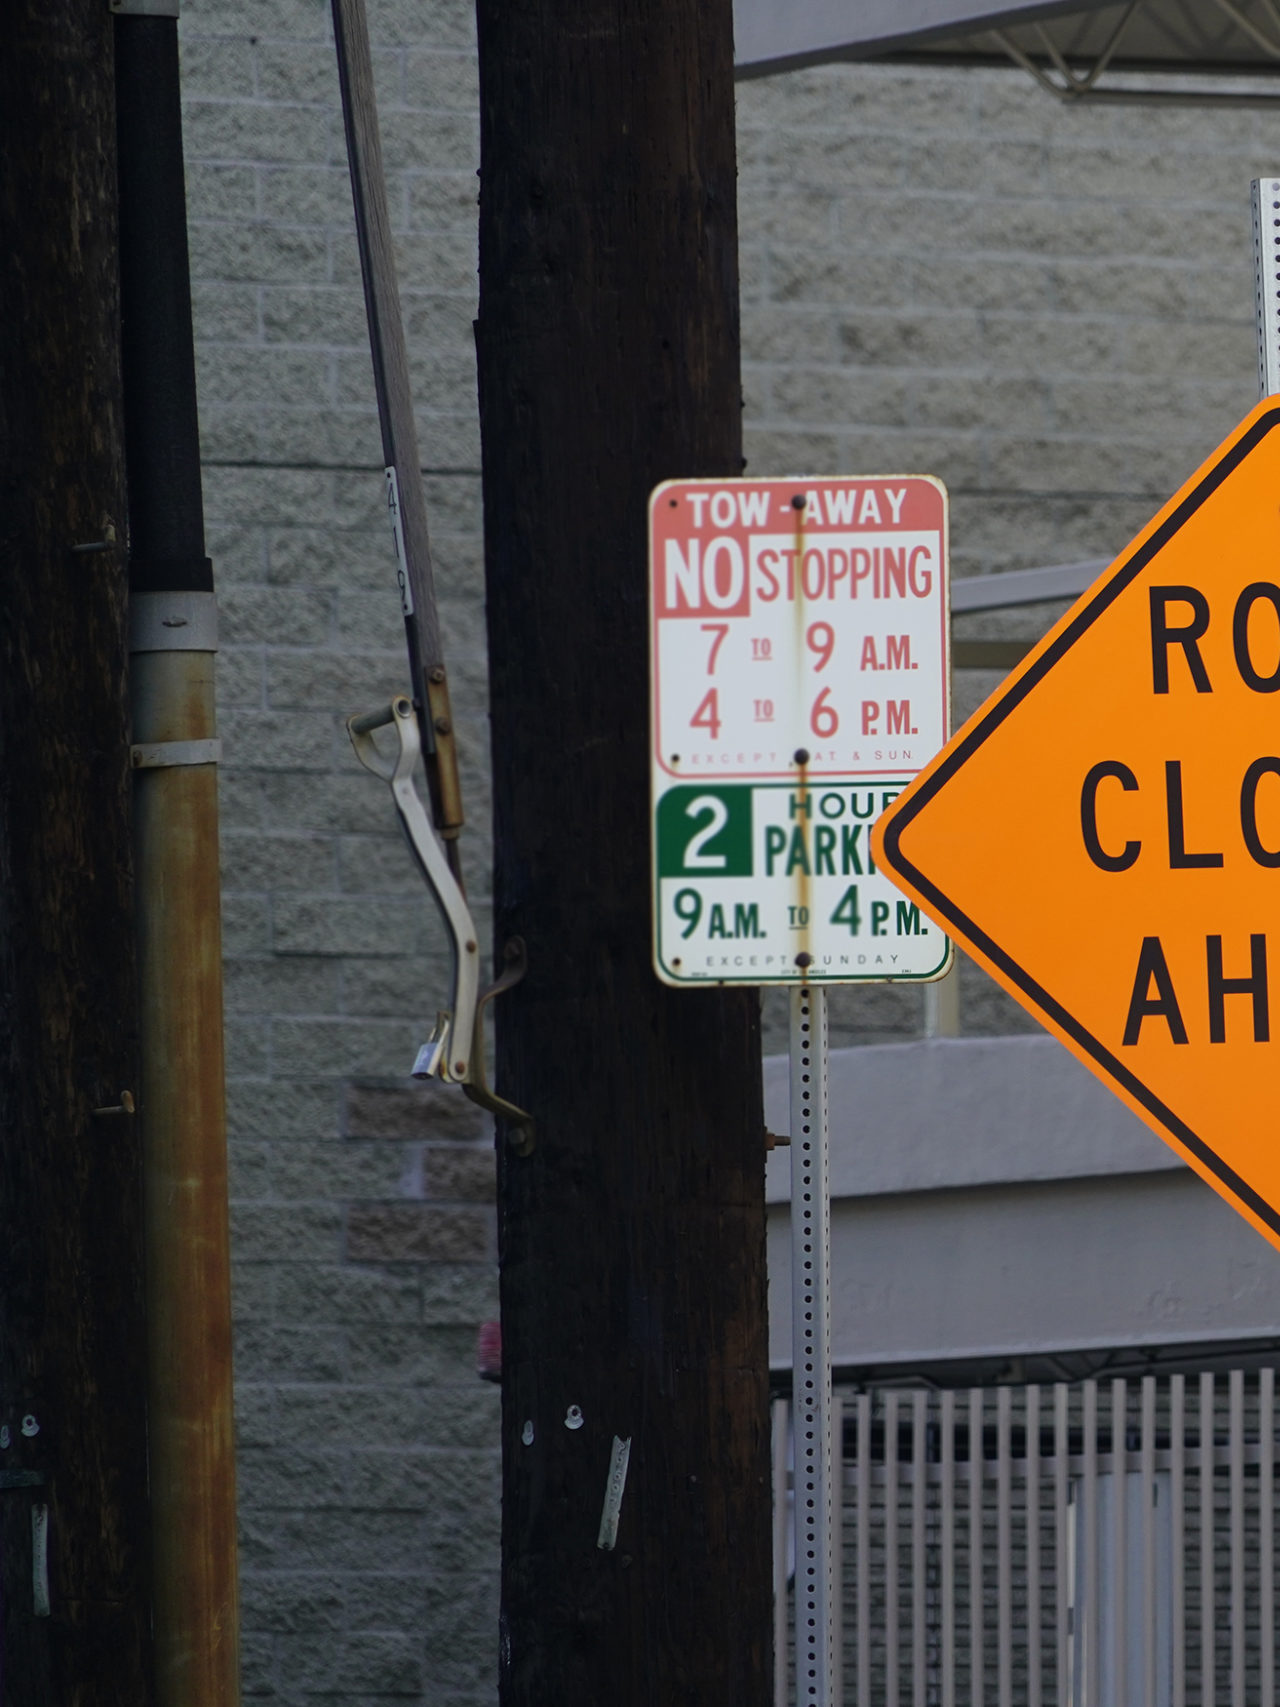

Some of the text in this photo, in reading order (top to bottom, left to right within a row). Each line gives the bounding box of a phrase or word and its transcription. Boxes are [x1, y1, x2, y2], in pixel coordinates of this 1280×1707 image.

[665, 536, 932, 610] NO STOPPING
[700, 620, 919, 676] 7 TO 9 A.M.
[689, 686, 919, 740] 4 TO 6 P.M.
[692, 752, 777, 764] EXCEPT
[852, 751, 861, 761] &
[683, 795, 728, 868] 2
[765, 824, 876, 877] PARK
[673, 884, 928, 940] 9 A.M. TO 4 P.M.
[706, 955, 787, 967] EXCEPT
